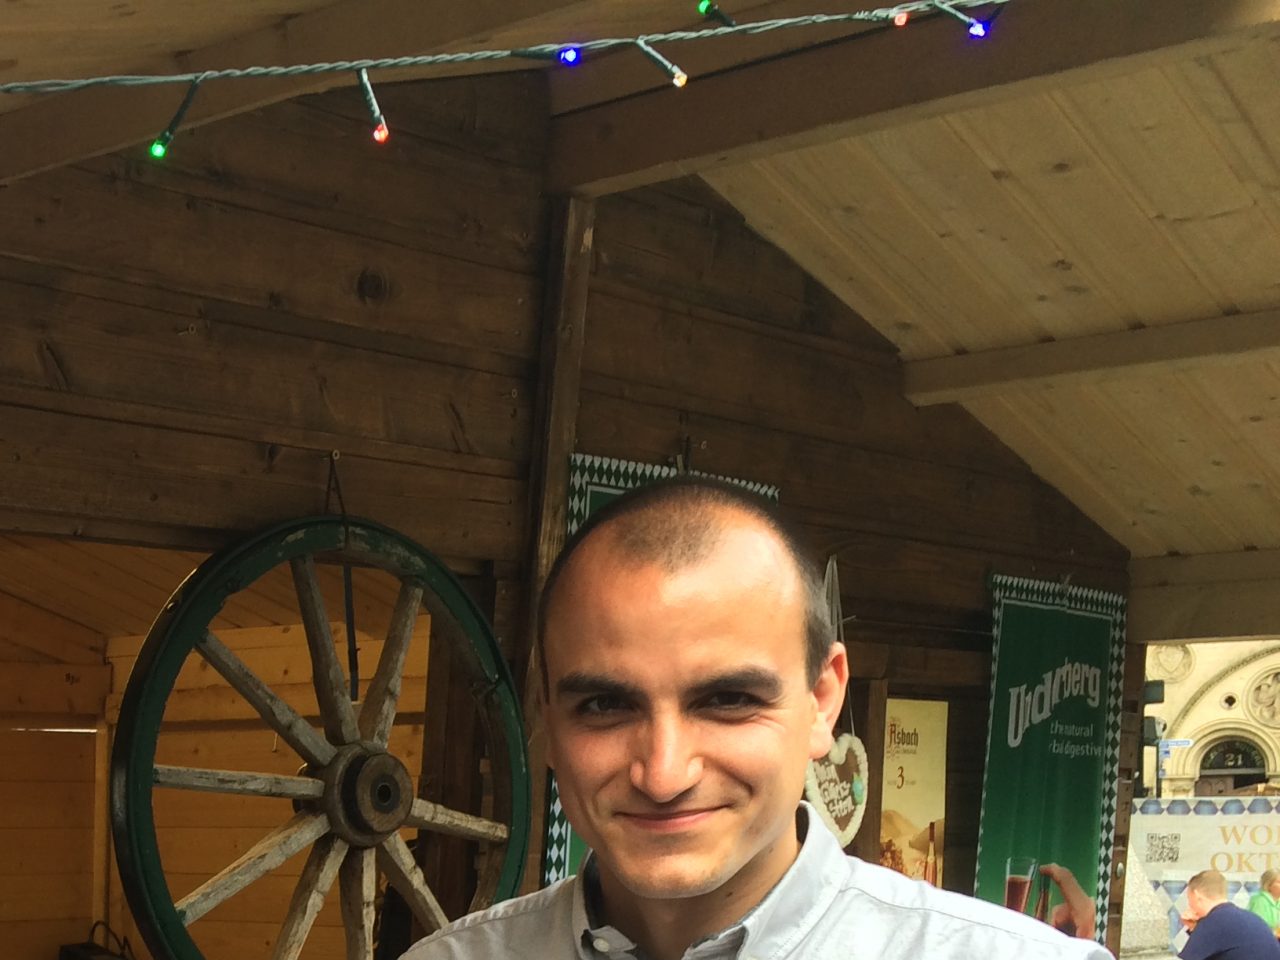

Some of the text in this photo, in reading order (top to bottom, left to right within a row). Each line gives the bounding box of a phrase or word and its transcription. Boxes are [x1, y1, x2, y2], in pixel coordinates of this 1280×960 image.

[888, 723, 919, 747] Asbach
[1224, 753, 1243, 766] 21
[896, 766, 905, 789] 3
[1210, 852, 1280, 873] OKT
